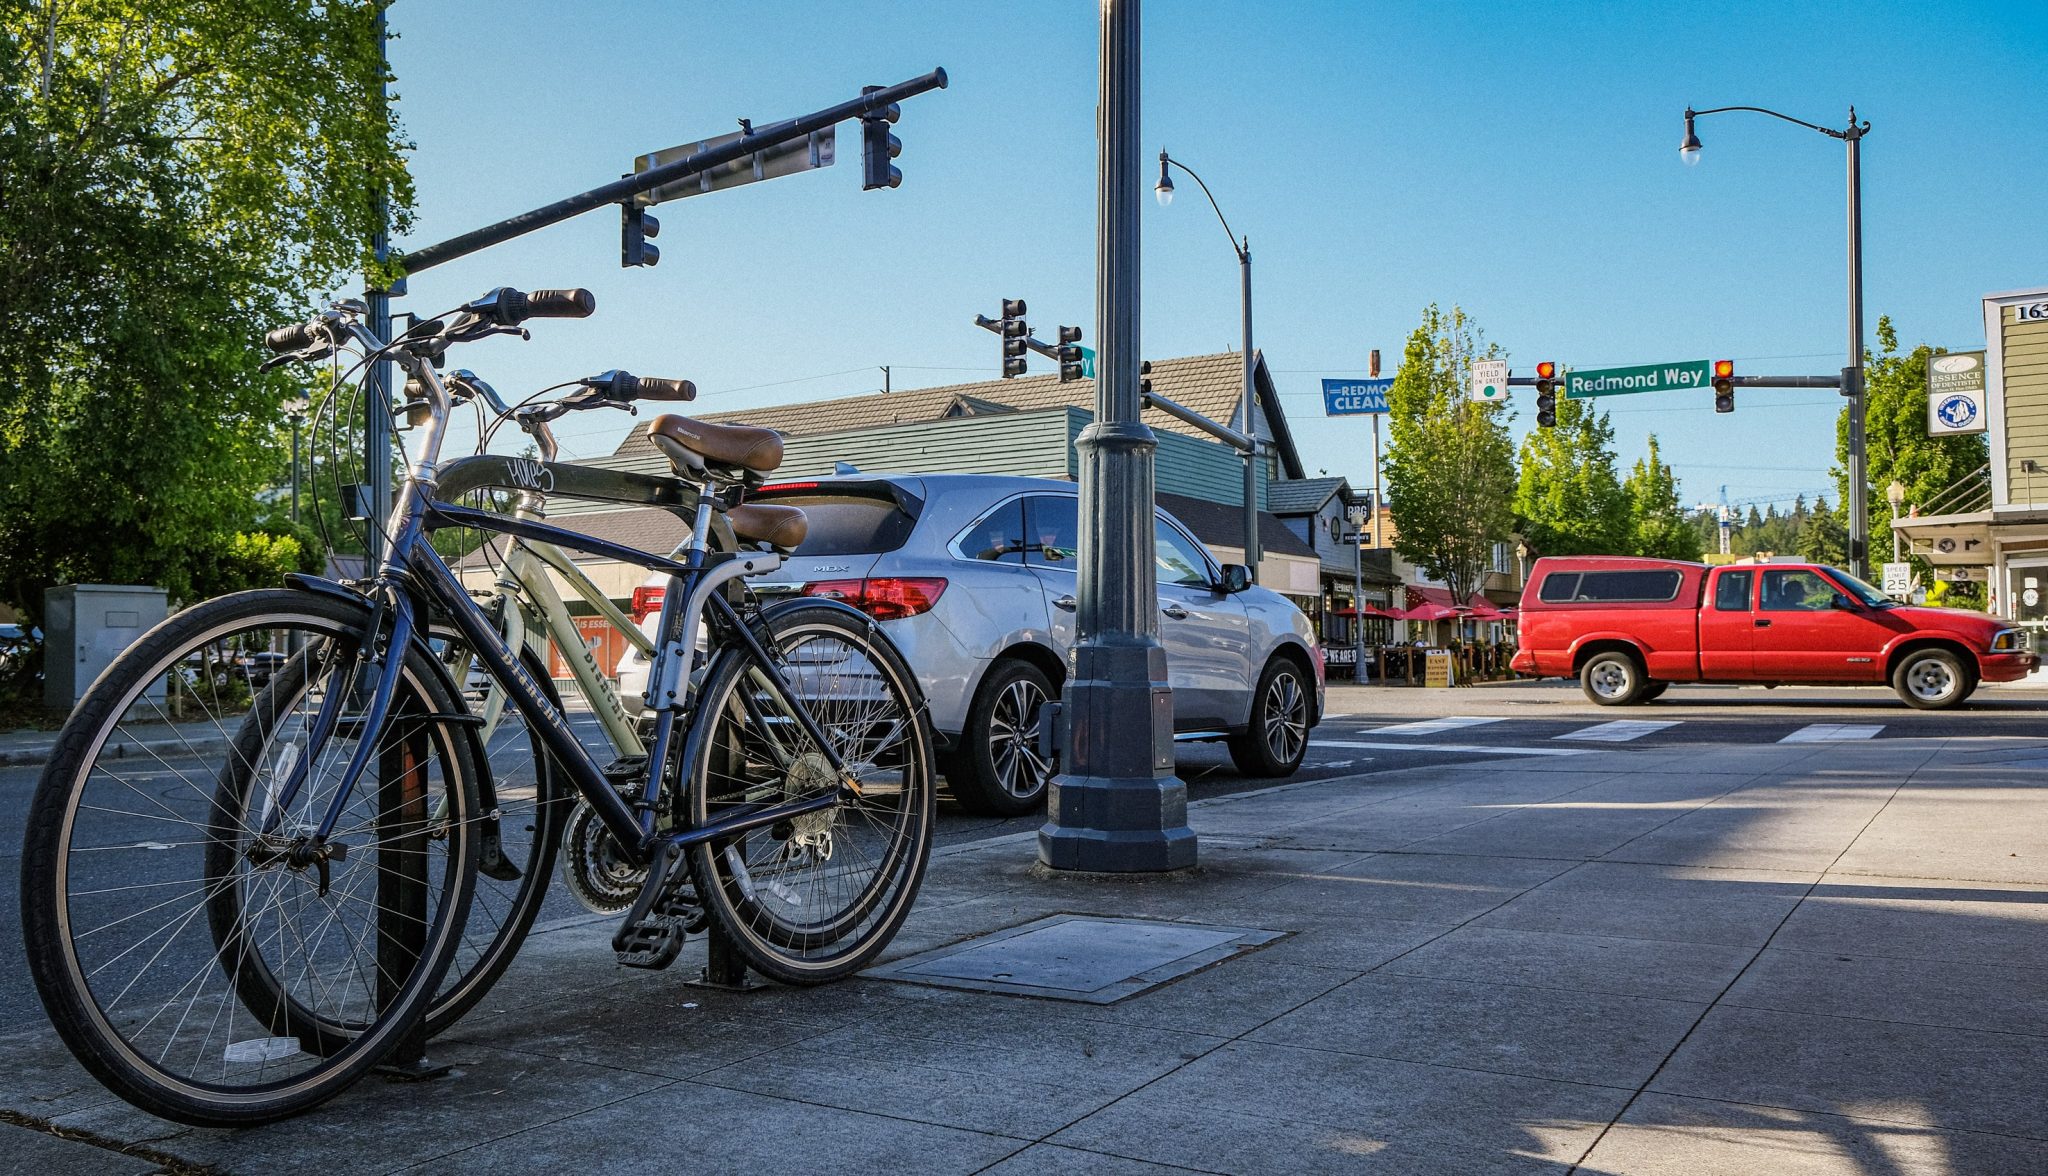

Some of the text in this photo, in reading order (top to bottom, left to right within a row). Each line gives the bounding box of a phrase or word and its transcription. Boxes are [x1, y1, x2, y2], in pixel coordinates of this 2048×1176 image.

[1475, 363, 1488, 371] LEFT
[1480, 370, 1499, 378] YIELD
[1931, 371, 1981, 383] ESSENCE
[1572, 368, 1704, 393] Redmond Way
[1942, 379, 1981, 388] DENTISTRY
[1341, 384, 1394, 396] REDMO
[814, 565, 850, 573] MDX
[1887, 579, 1907, 590] 25
[580, 621, 588, 629] IS
[1329, 649, 1339, 662] WE
[1340, 649, 1352, 663] ARE
